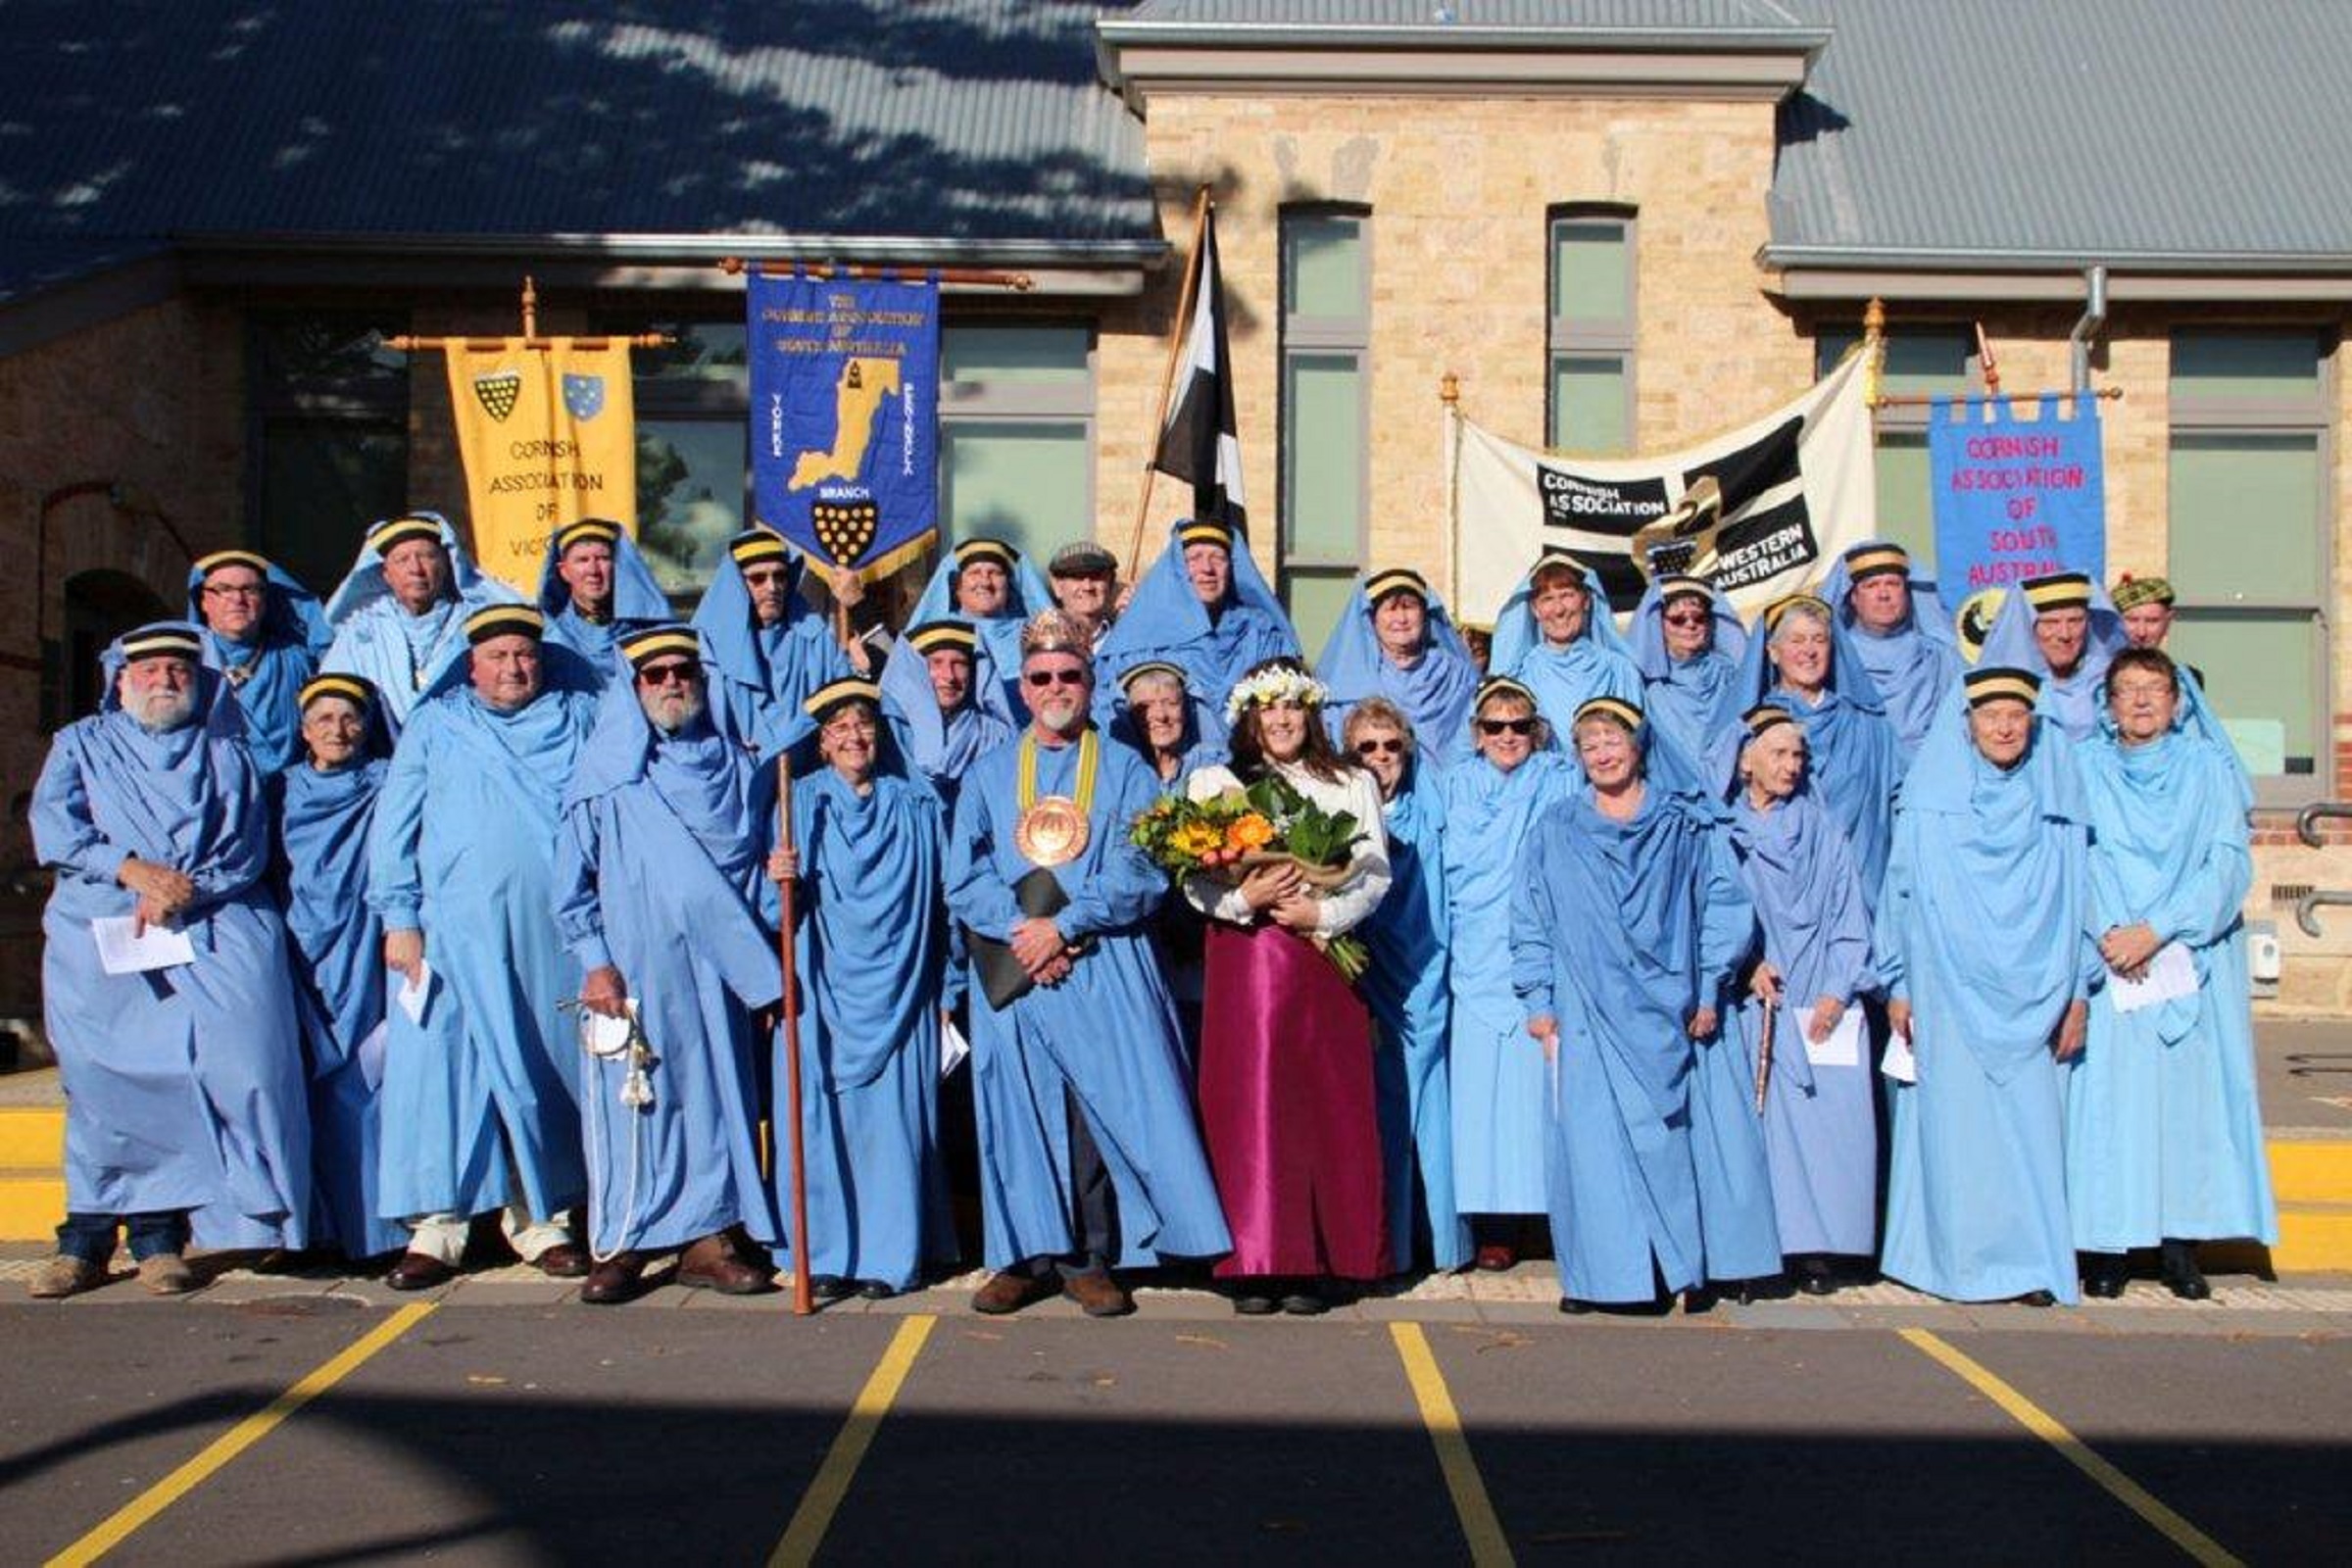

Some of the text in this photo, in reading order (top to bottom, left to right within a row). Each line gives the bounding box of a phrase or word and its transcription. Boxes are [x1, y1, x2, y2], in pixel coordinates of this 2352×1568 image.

[1967, 437, 2059, 460] CORNISH
[490, 474, 604, 494] ASSOCIATION
[1952, 465, 2083, 492] ASSOCIATION
[819, 486, 870, 499] BRANCH
[1549, 493, 1665, 515] ASSOCIATION
[2007, 497, 2035, 519] OF
[1717, 522, 1803, 571] WESTERN
[1713, 543, 1809, 591] AUSTRALIA
